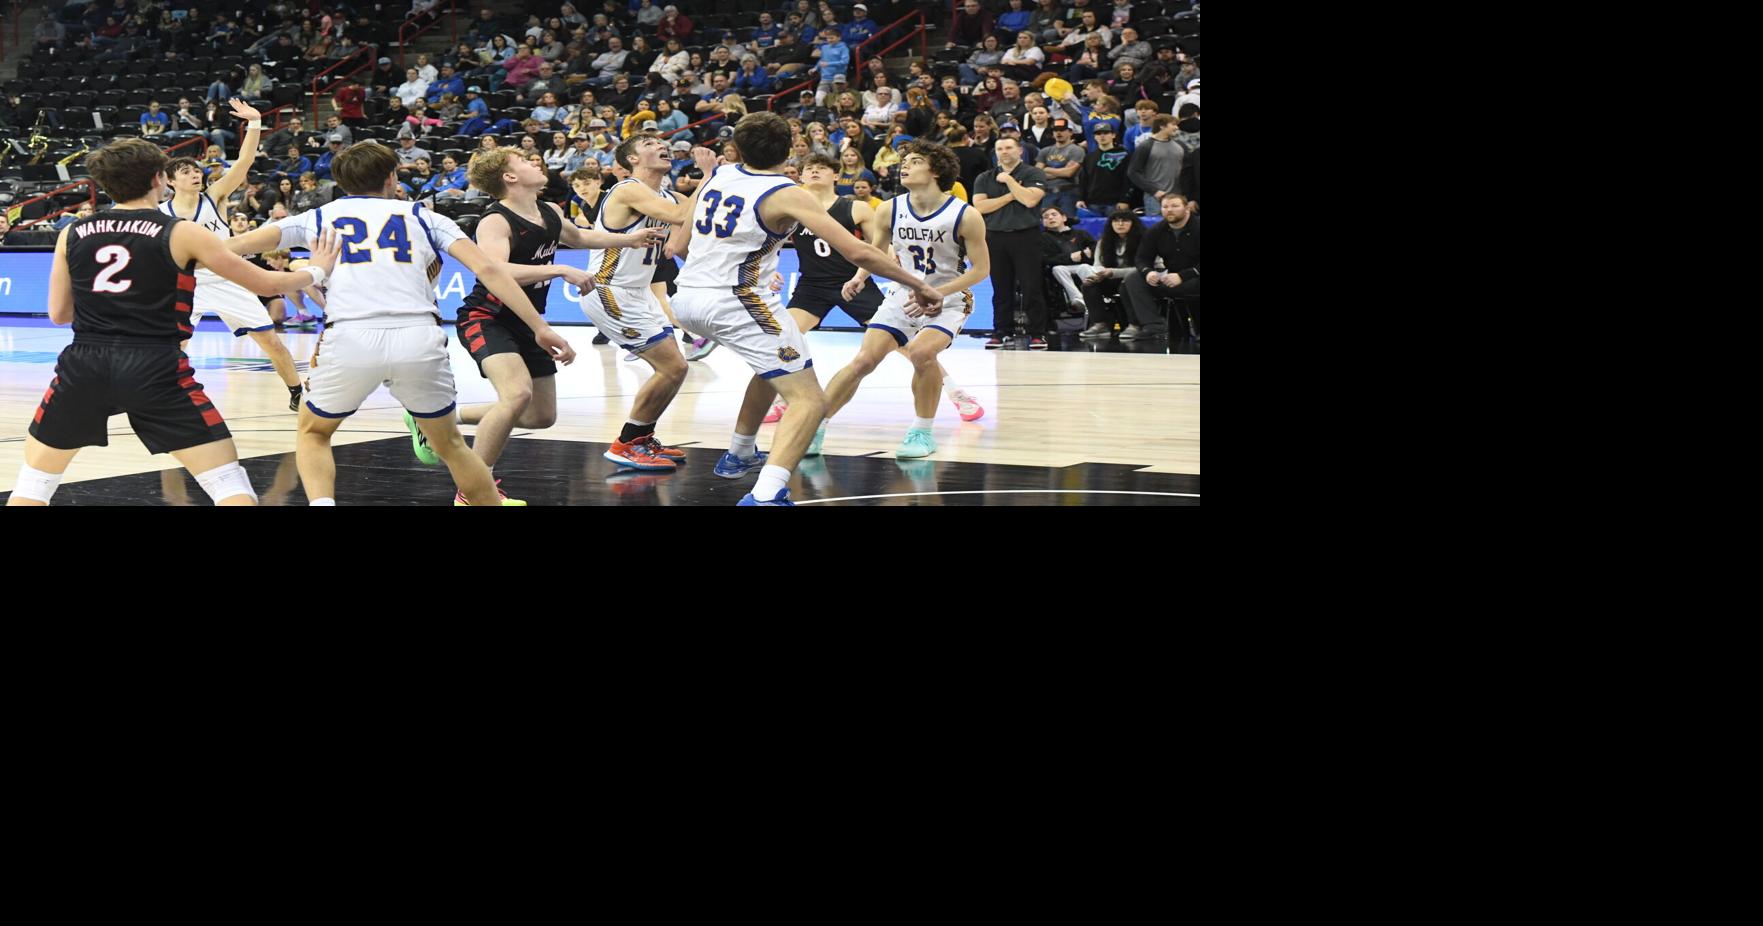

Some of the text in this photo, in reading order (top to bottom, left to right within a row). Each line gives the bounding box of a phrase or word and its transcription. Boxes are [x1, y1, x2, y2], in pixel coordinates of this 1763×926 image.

[75, 219, 163, 239] WAHKIAKUM
[695, 189, 746, 239] 33
[330, 213, 414, 264] 24
[813, 238, 832, 258] 0
[898, 227, 947, 243] COLFAX
[92, 244, 133, 294] 2
